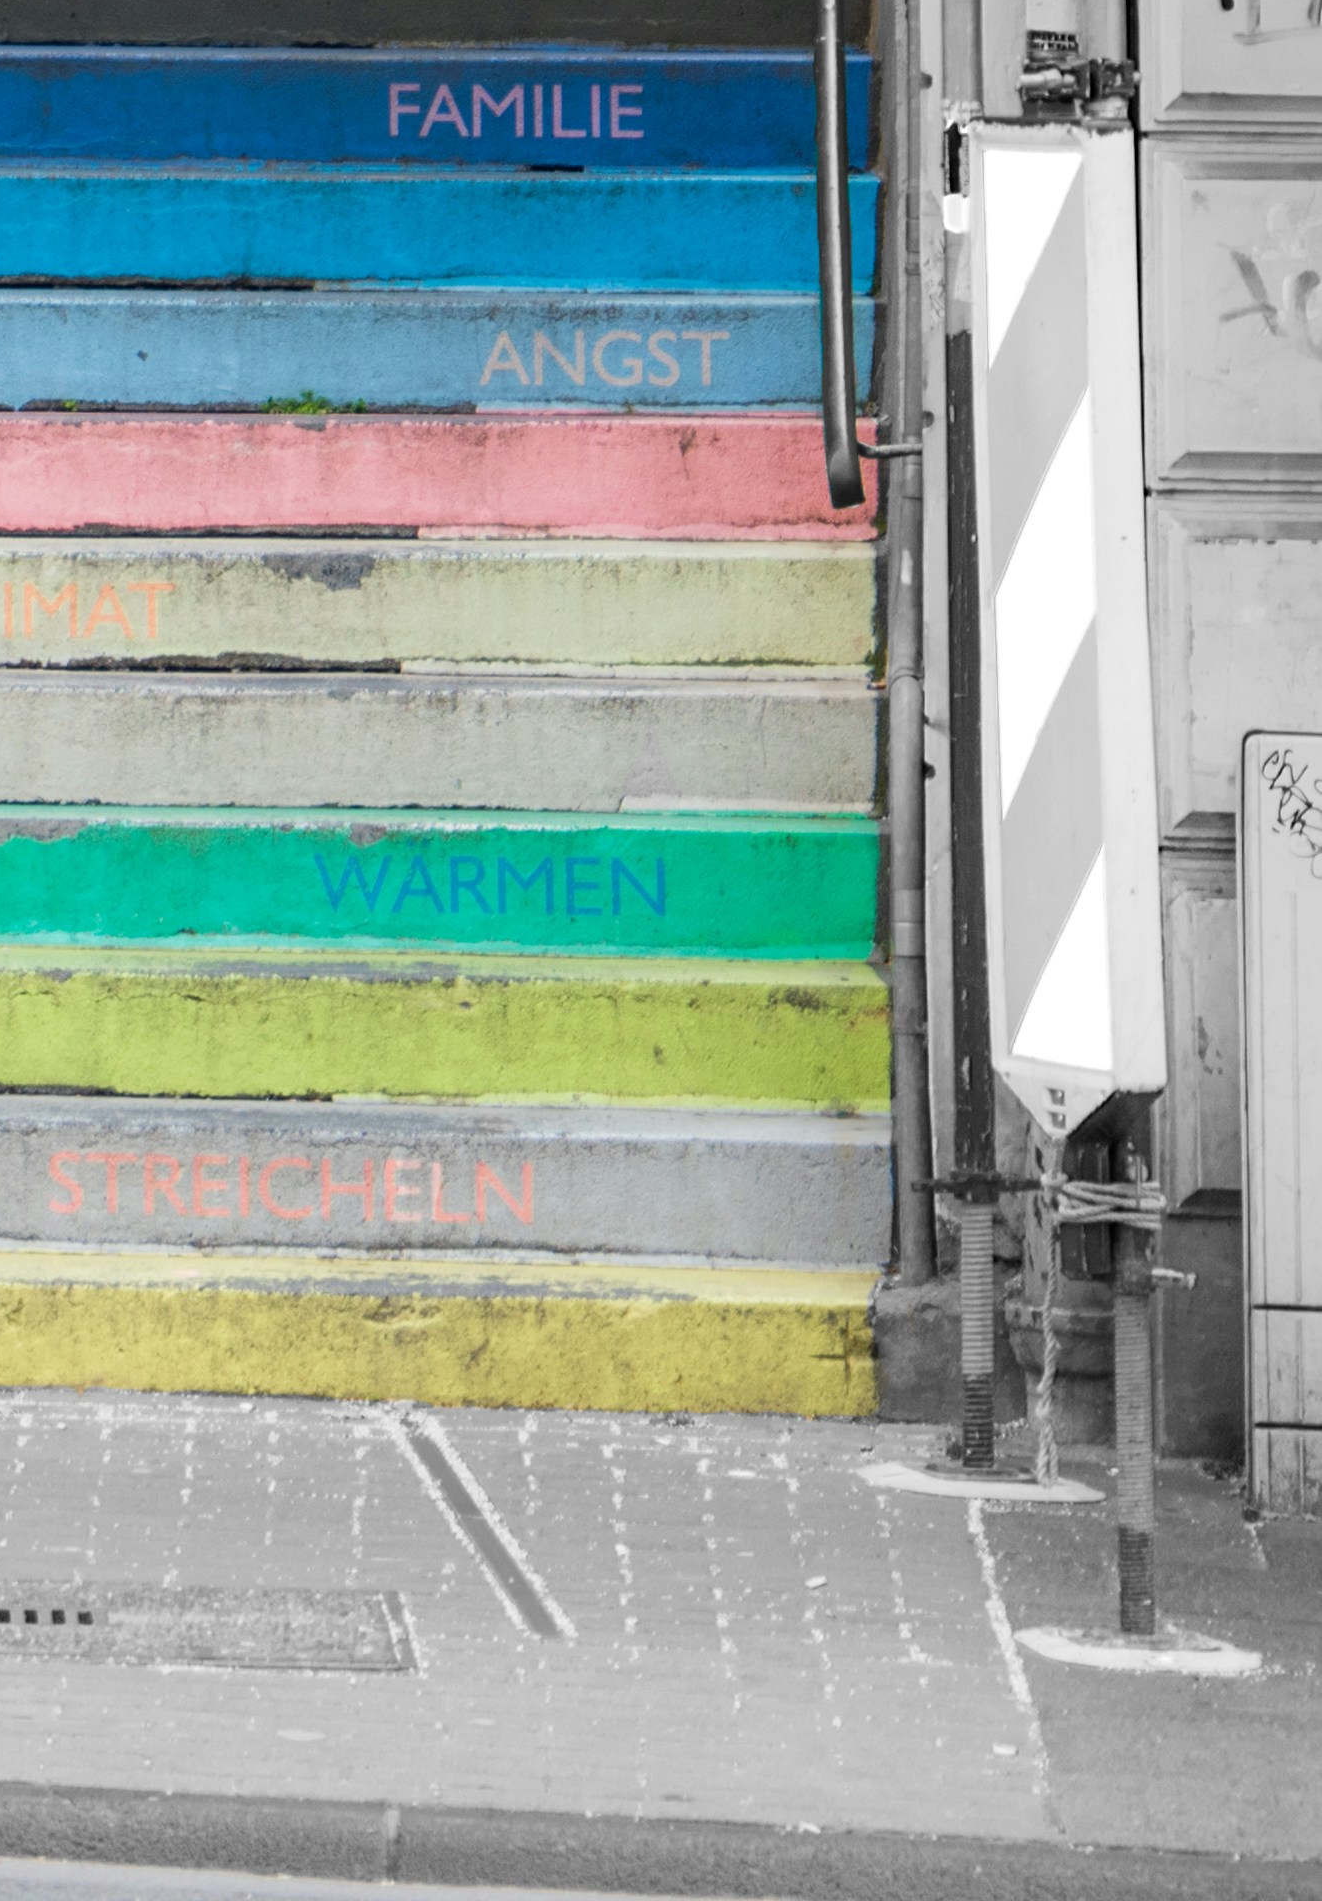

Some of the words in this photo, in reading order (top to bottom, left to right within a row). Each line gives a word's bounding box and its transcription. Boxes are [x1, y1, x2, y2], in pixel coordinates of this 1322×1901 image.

[388, 83, 644, 139] FAMILIE
[480, 330, 730, 387] ANGST
[49, 1152, 535, 1225] STREICHELN
